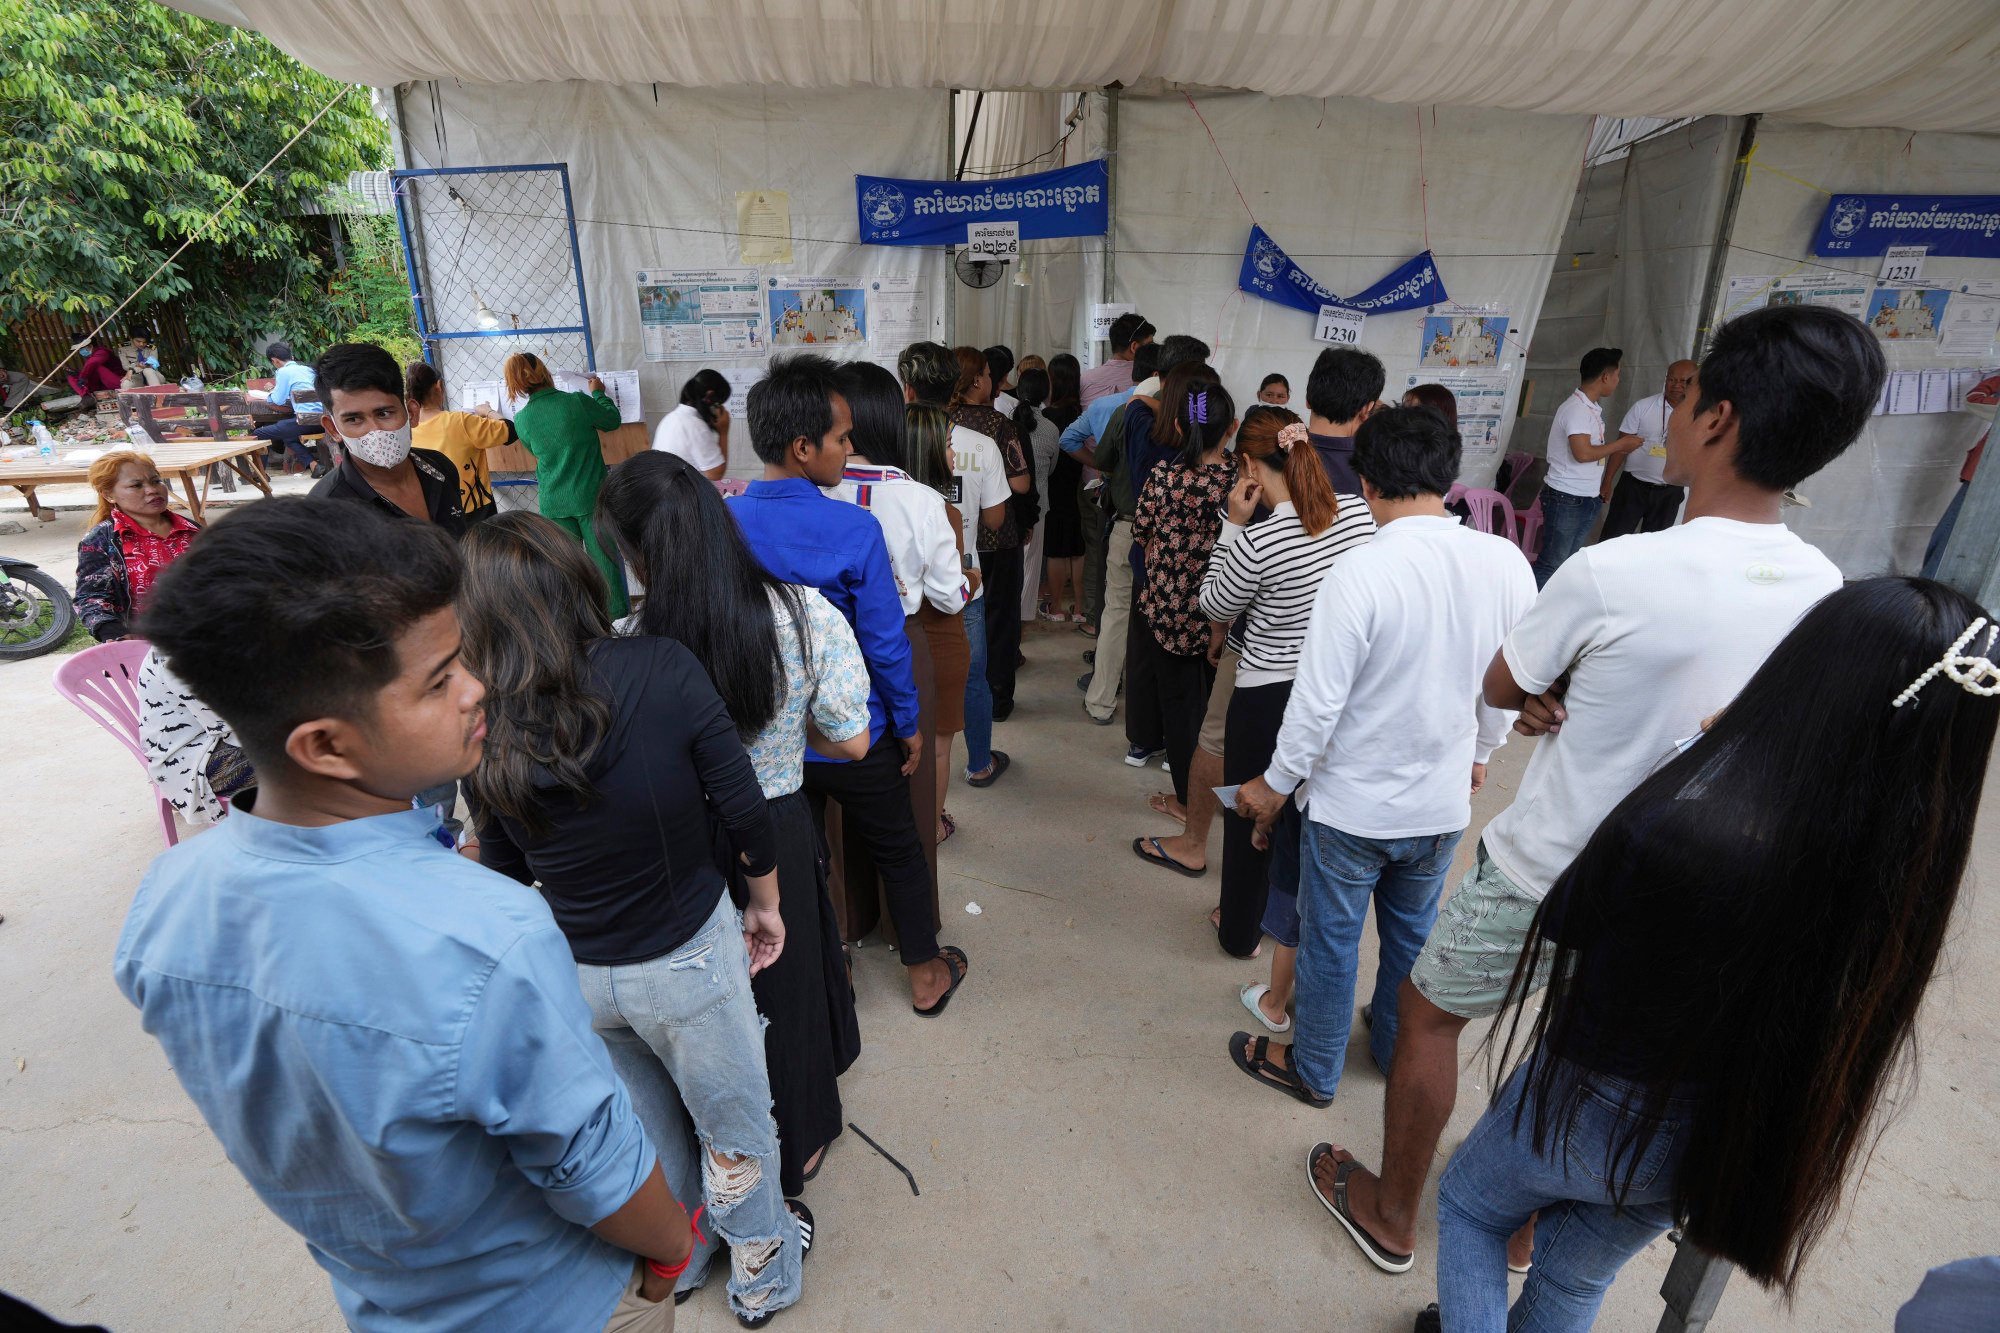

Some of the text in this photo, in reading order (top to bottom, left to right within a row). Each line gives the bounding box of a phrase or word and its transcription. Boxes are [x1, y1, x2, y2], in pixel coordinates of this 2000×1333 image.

[913, 185, 1100, 213] ការិយាល័យបោះឆ្នោត
[974, 228, 1015, 237] ការិយាល័យ
[973, 240, 1018, 254] ១២២៩
[1886, 266, 1917, 280] 1231
[1322, 325, 1357, 344] 1230
